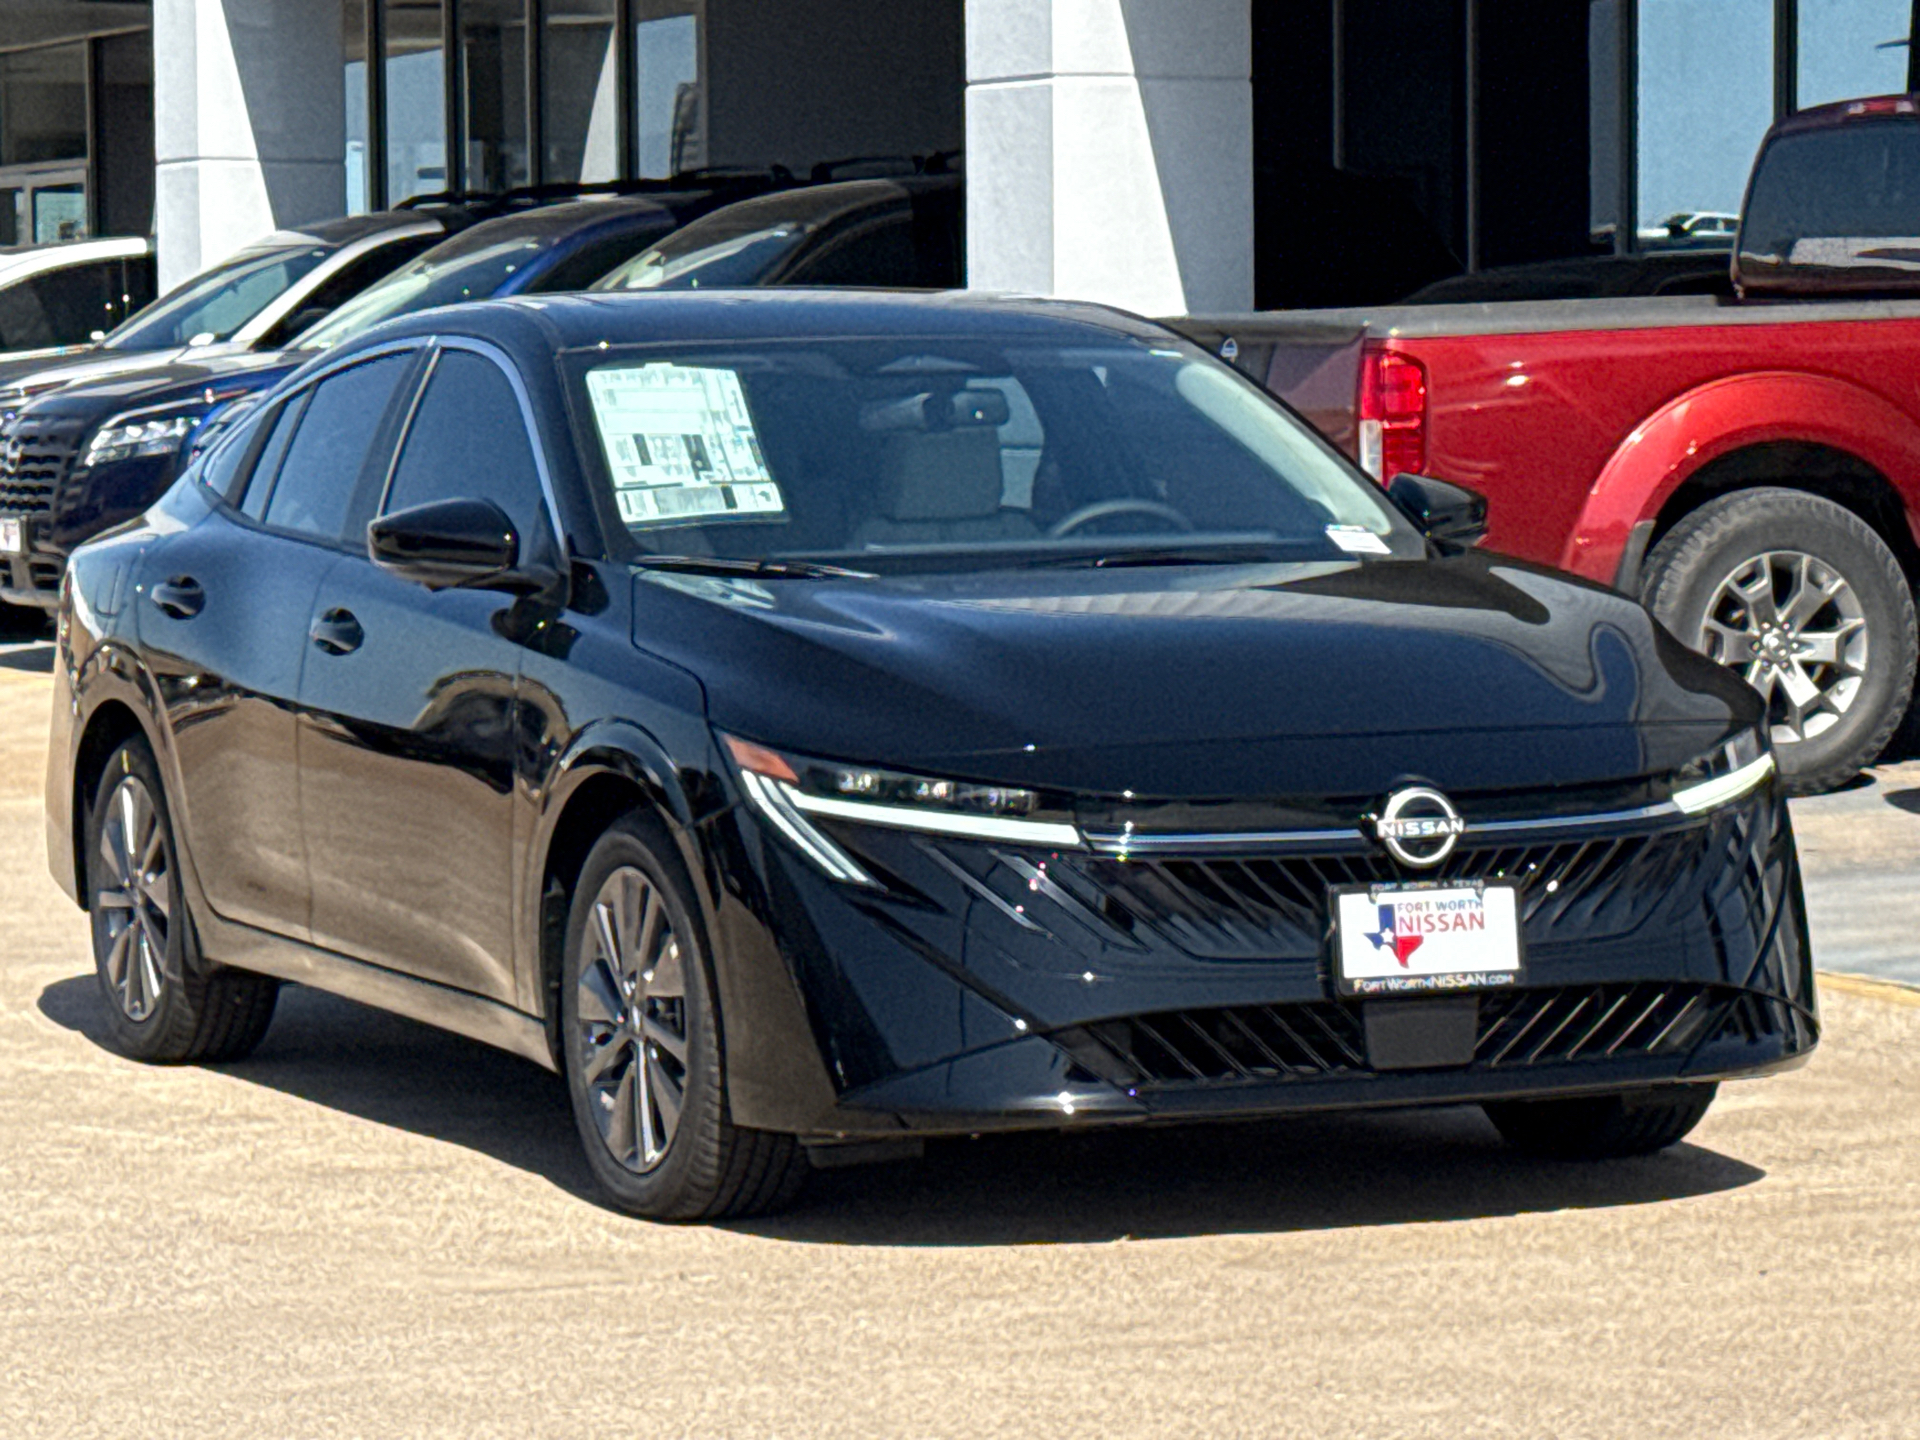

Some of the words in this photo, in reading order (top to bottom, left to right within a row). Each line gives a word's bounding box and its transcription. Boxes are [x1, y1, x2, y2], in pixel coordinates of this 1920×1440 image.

[1378, 818, 1463, 837] NISSAN
[1371, 883, 1397, 892] FORT
[1397, 901, 1430, 913] FORT
[1435, 899, 1484, 911] WORTH
[1399, 912, 1485, 933] NISSAN
